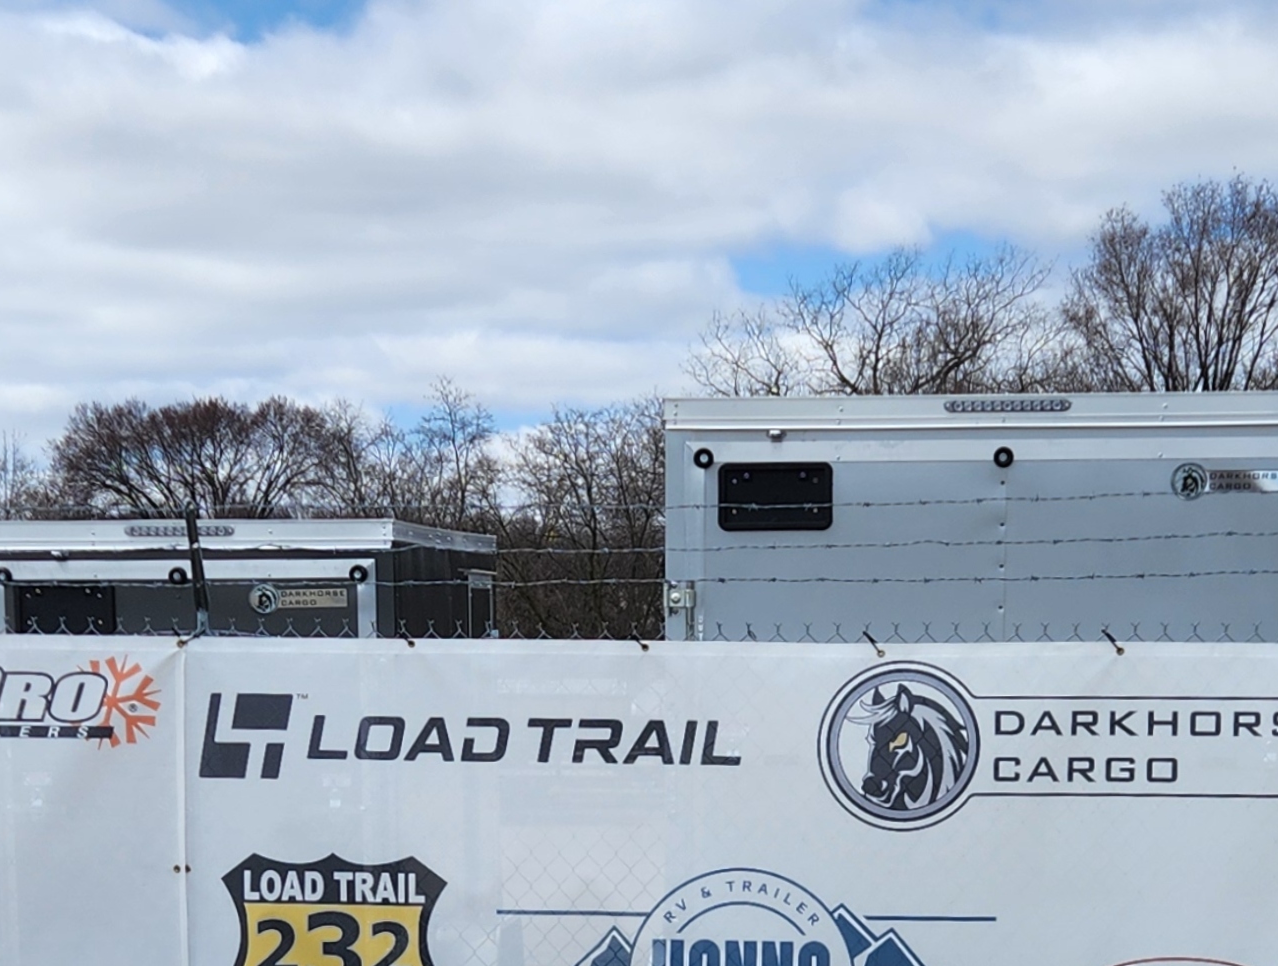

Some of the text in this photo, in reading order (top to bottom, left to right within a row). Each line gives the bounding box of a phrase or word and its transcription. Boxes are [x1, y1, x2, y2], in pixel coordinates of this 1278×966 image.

[1209, 482, 1251, 490] CARGO
[307, 714, 742, 766] LOAD TRAIL
[993, 756, 1179, 783] CARGO
[243, 869, 426, 904] LOAD TRAIL
[663, 880, 820, 926] RV & TRAILER
